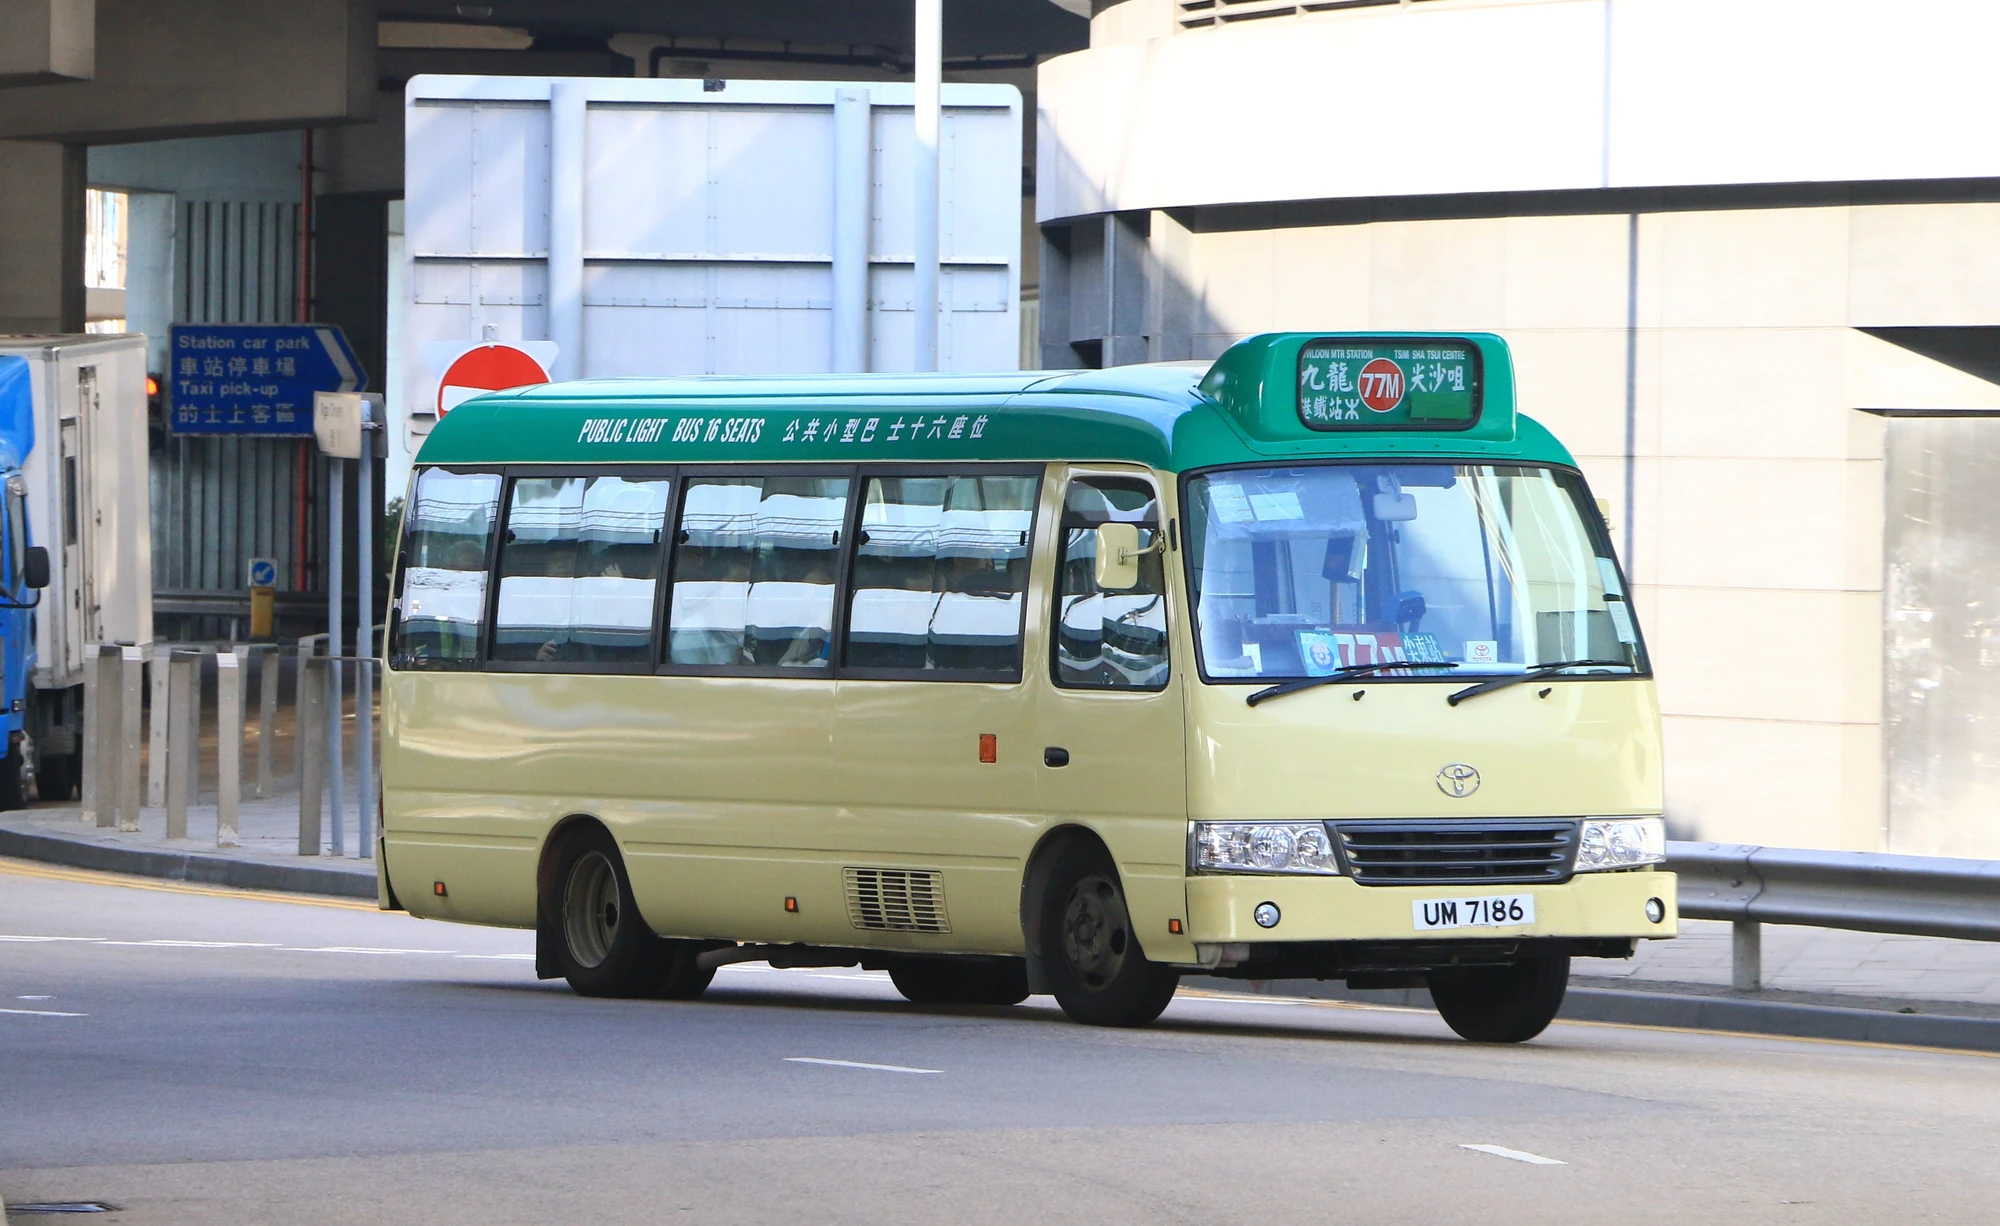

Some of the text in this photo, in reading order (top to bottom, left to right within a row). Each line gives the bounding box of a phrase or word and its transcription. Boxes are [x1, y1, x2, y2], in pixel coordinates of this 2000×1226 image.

[179, 335, 310, 353] Station car park
[1330, 349, 1346, 359] MTR
[1346, 349, 1373, 359] STATION
[1394, 349, 1466, 360] TSIM SHA TSUI CENTRE
[179, 356, 296, 377] 車站停車場
[1301, 361, 1354, 393] 九龍
[1361, 373, 1399, 399] 77M
[1409, 362, 1465, 393] 尖沙咀
[179, 380, 279, 398] Taxi pick-up
[179, 403, 296, 424] 的士上客區
[577, 417, 765, 444] PUBLIC LIGHT BUS 16 SEATS
[1423, 898, 1524, 926] UM 7186
